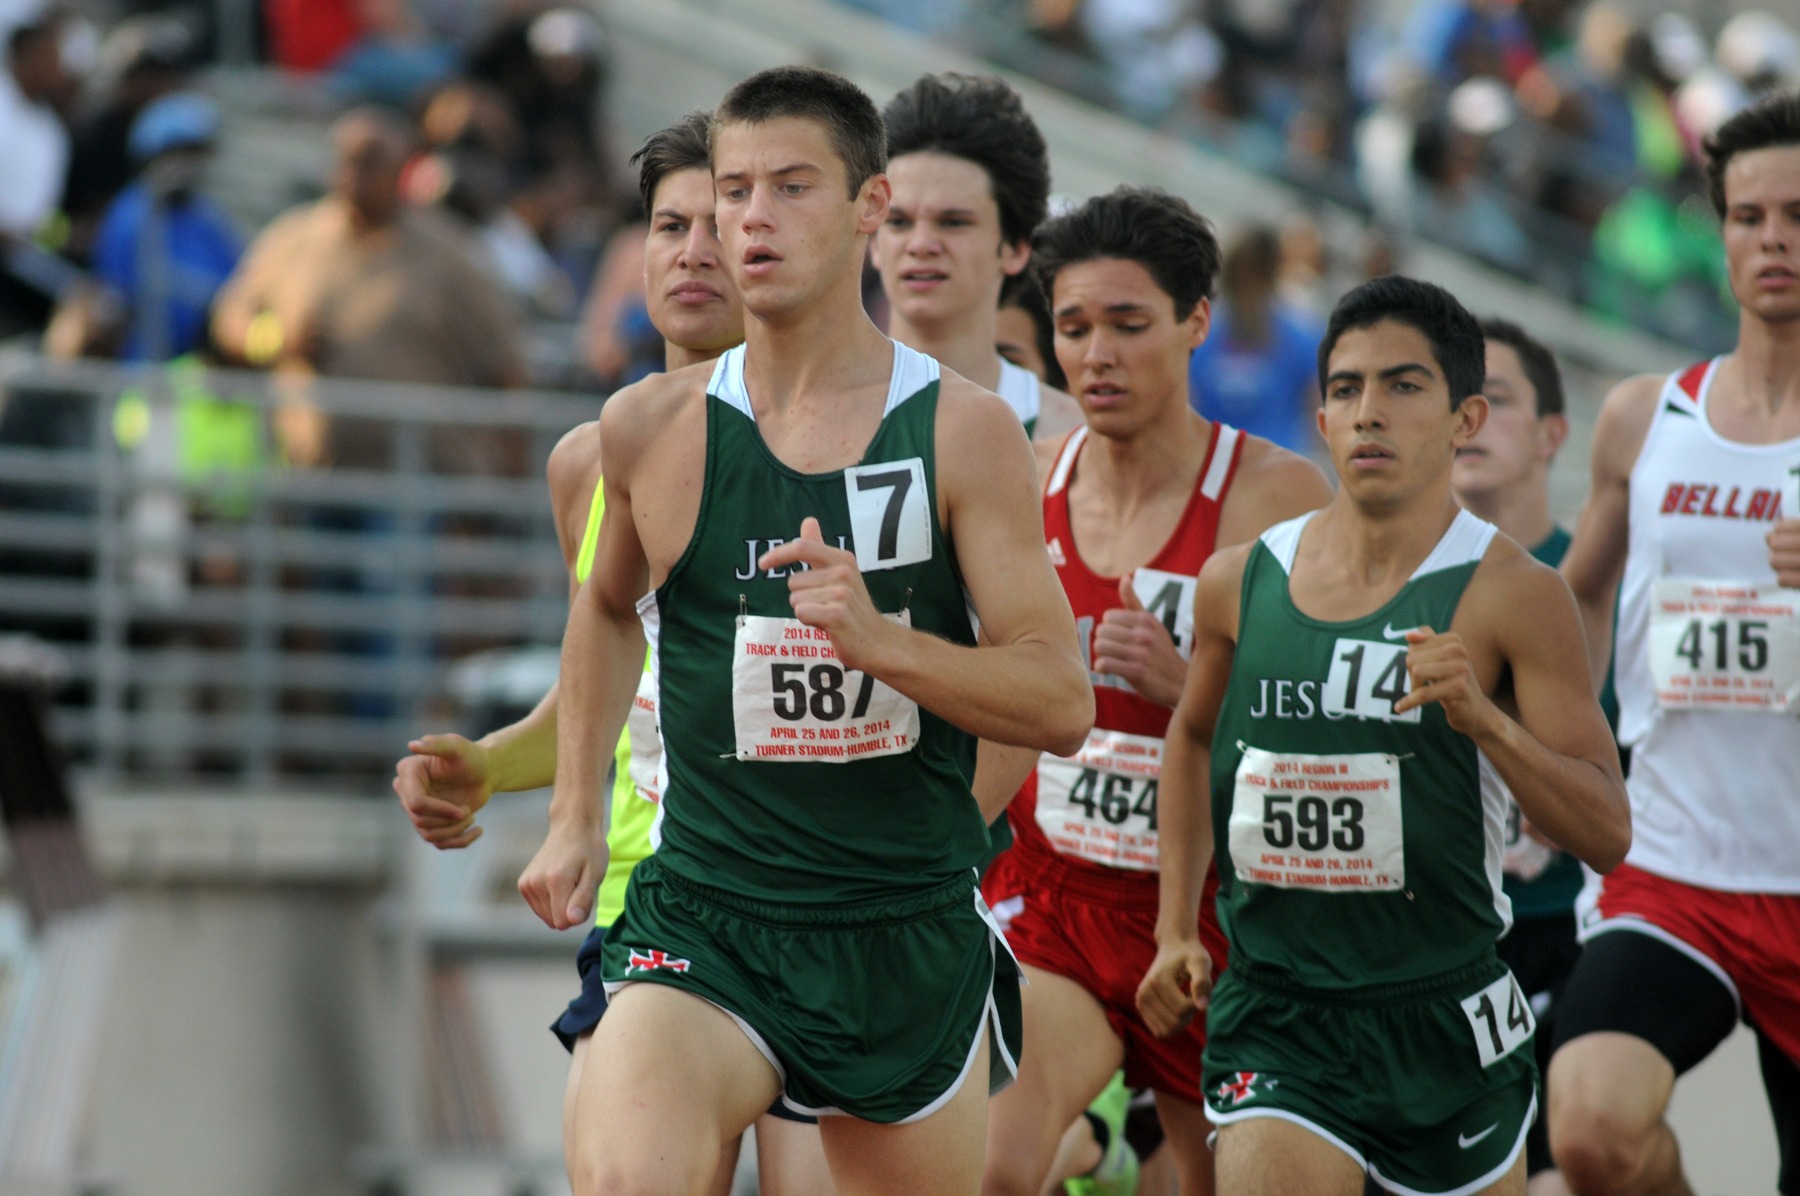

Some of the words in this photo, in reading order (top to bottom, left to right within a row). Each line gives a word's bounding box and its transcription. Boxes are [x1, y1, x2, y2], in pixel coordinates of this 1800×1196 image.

[856, 468, 913, 561] 7
[746, 643, 777, 656] TRACK
[780, 645, 789, 657] &
[792, 645, 818, 658] FIELD
[784, 627, 811, 640] 2014
[1676, 620, 1768, 672] 415
[771, 663, 875, 722] 587
[1338, 644, 1409, 715] 14
[755, 745, 796, 757] TURNER
[894, 734, 908, 747] TX
[770, 727, 799, 740] APRIL
[802, 729, 816, 740] 25
[819, 729, 841, 740] AND
[843, 726, 861, 740] 26,
[864, 719, 891, 736] 2014
[1273, 762, 1299, 774] 2014
[1302, 763, 1336, 775] REGION
[1281, 778, 1305, 790] FIELD
[1309, 779, 1389, 792] CHAMPIONSHIPS
[1069, 766, 1158, 831] 464
[1263, 794, 1364, 852] 593
[1305, 858, 1323, 869] AND
[1347, 858, 1373, 869] 2014
[1473, 977, 1531, 1056] 14
